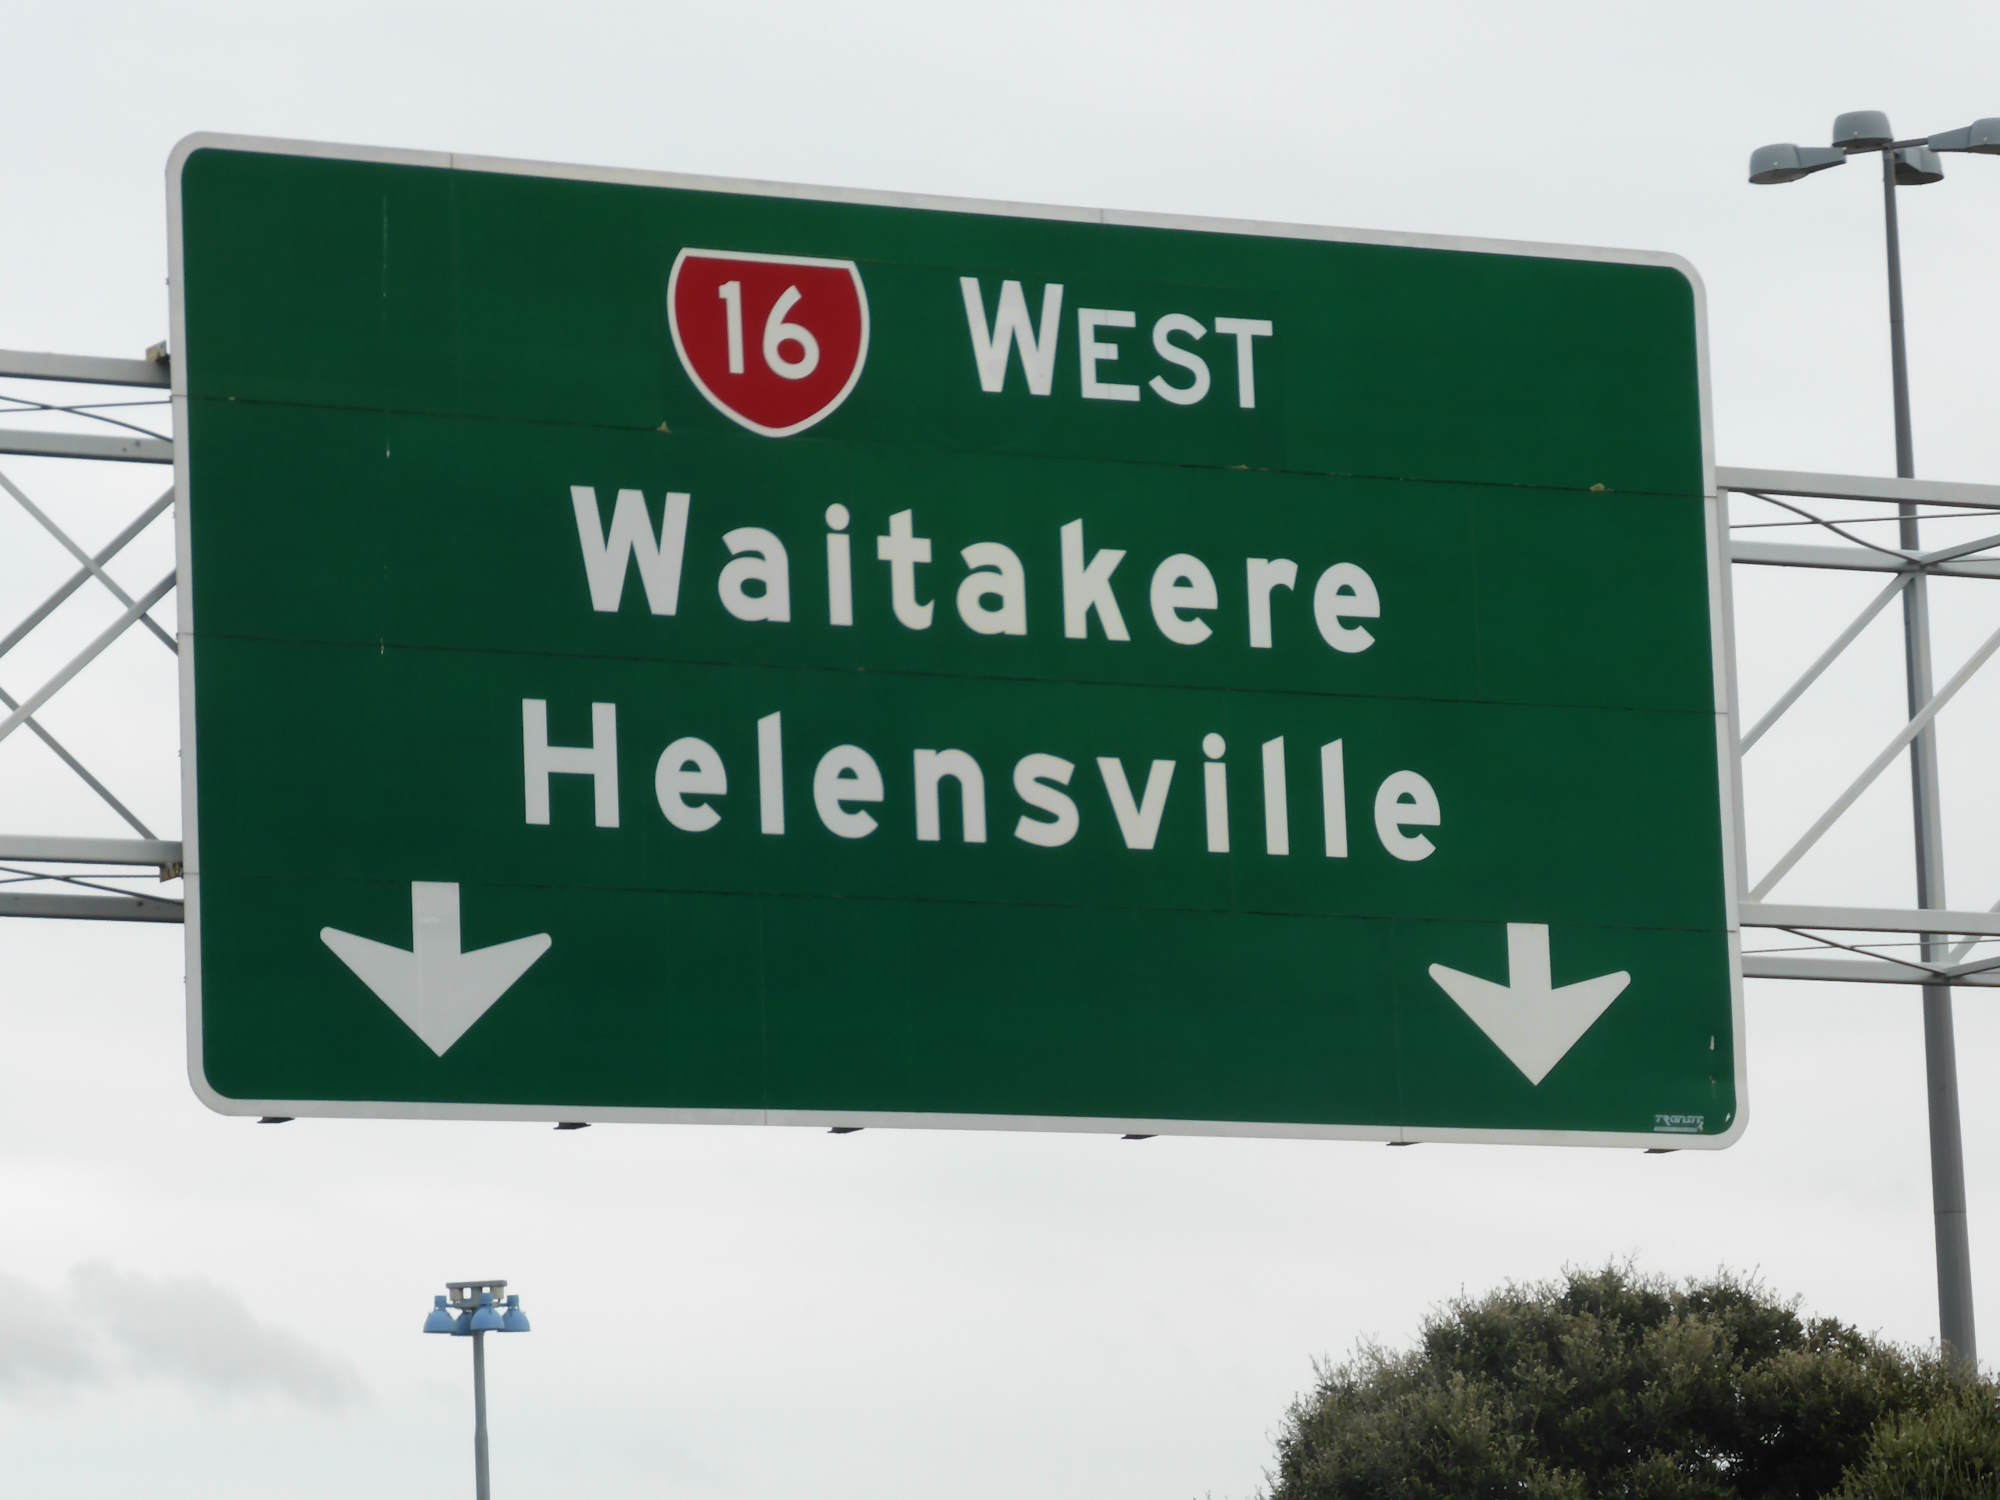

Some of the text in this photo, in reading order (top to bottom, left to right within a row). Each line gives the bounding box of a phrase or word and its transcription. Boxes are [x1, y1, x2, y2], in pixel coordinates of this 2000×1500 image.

[718, 280, 821, 380] 16
[959, 276, 1274, 410] WEST
[570, 485, 1382, 655] Waitakere
[522, 698, 1441, 863] Helensville
